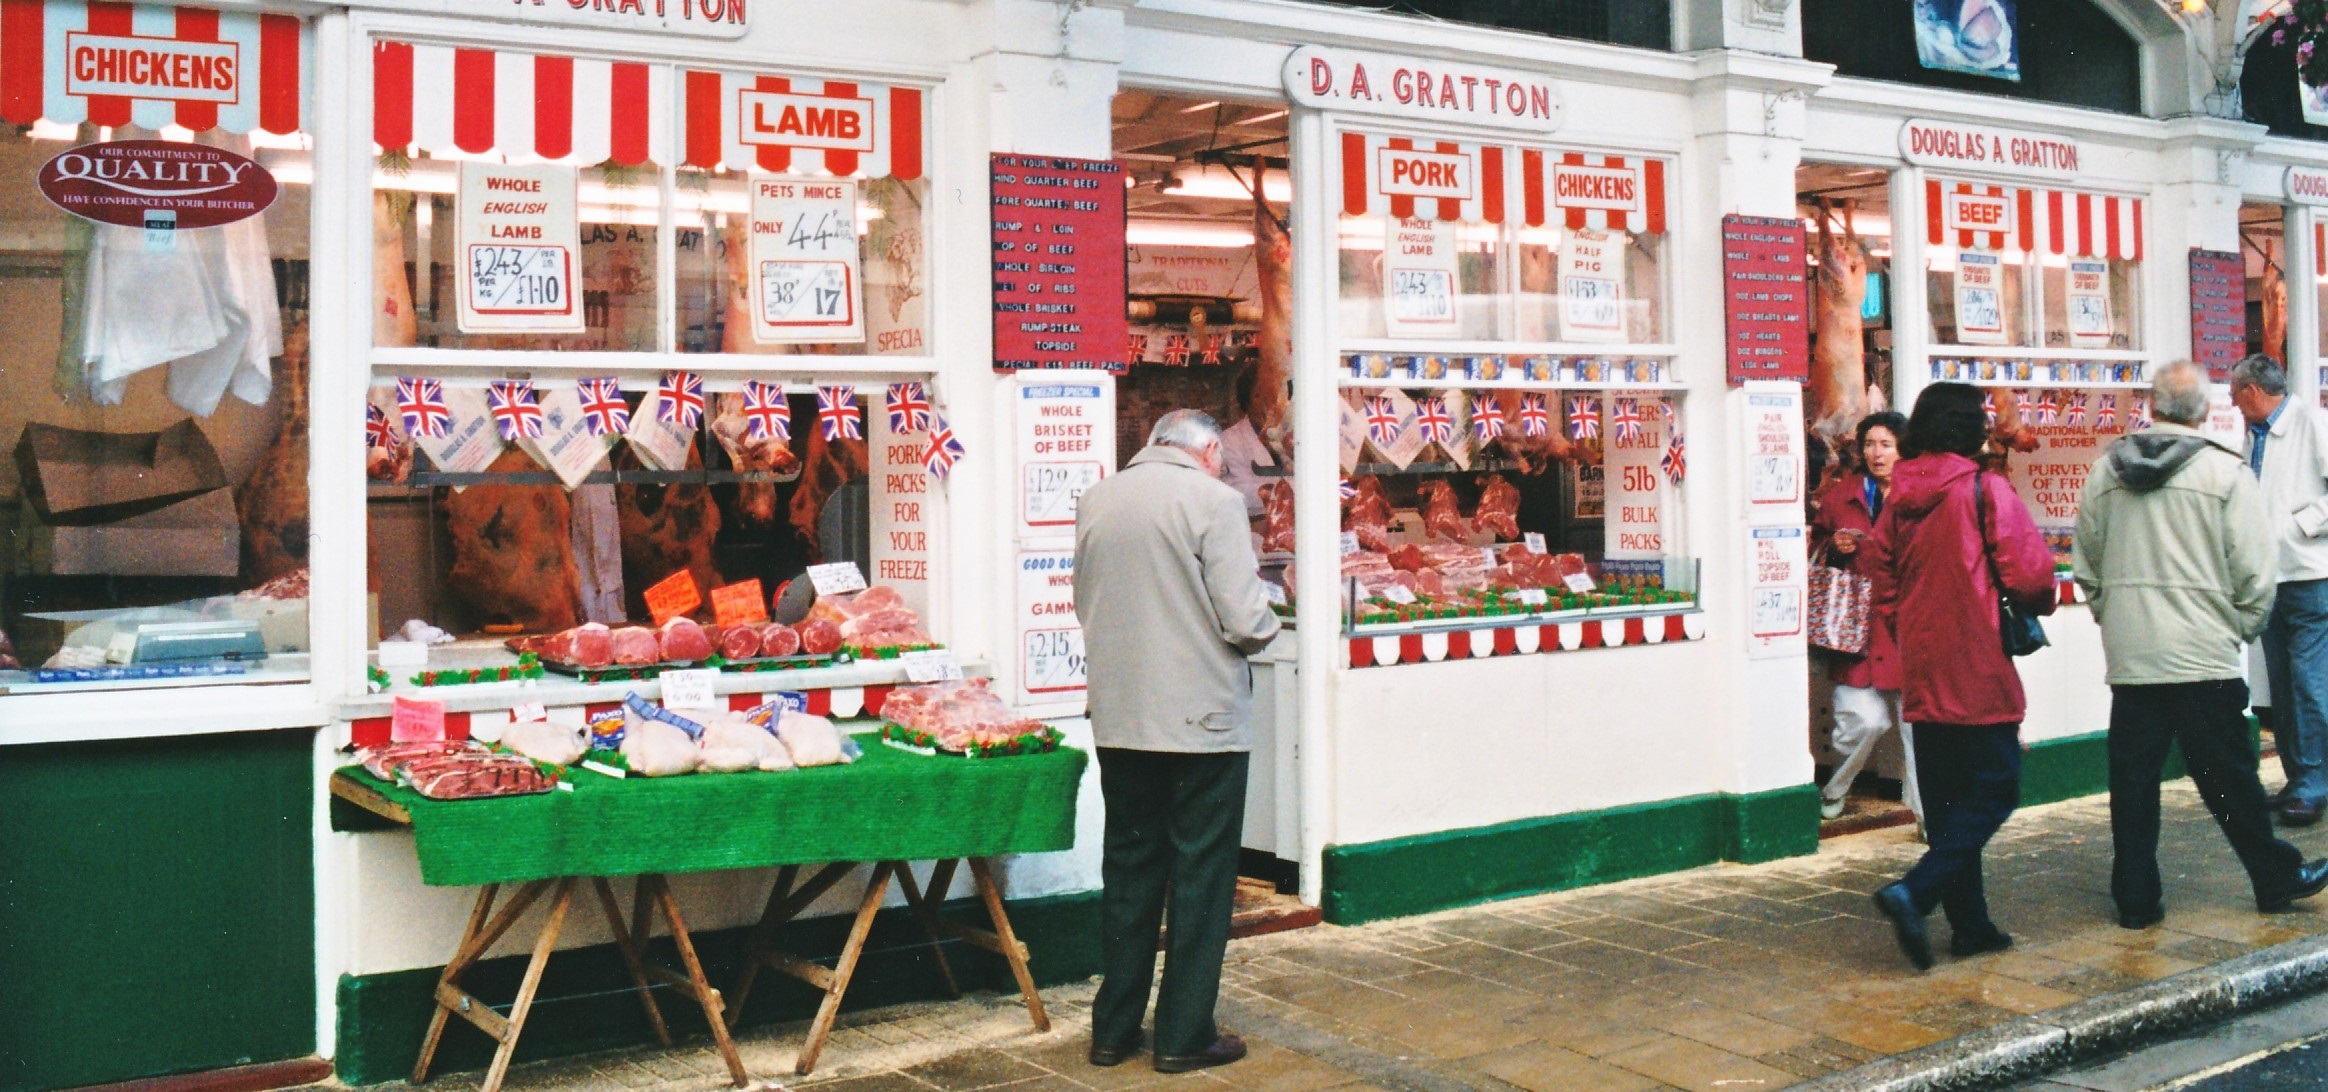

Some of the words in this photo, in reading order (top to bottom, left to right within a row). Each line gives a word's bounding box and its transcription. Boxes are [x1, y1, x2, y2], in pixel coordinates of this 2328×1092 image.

[75, 46, 233, 90] CHICKENS
[1311, 57, 1339, 96] D.
[1350, 63, 1382, 101] A.
[1393, 68, 1550, 119] GRATTON
[754, 102, 861, 139] LAMB
[100, 147, 123, 157] OUR
[127, 149, 201, 160] COMMITMENT
[207, 153, 220, 161] TO
[1911, 126, 1986, 161] DOUGLAS
[2011, 137, 2079, 172] GRATTON
[55, 153, 252, 184] QUALITY
[1393, 158, 1458, 188] PORK
[487, 177, 541, 192] WHOLE
[1024, 176, 1069, 186] QUARTER
[1073, 180, 1099, 189] BEEF
[1558, 173, 1634, 202] CHICKENS
[761, 184, 794, 198] PETS
[804, 186, 842, 199] MINCE
[64, 194, 89, 204] HAVE
[94, 196, 160, 206] CONFIDENCE
[163, 198, 174, 207] IN
[176, 199, 204, 208] YOUR
[208, 200, 255, 210] BUTCHER
[484, 202, 548, 214] ENGLISH
[1074, 201, 1099, 210] BEEF
[1959, 201, 2003, 225] BEEF
[492, 225, 542, 239] LAMB
[754, 221, 783, 234] ONLY
[995, 222, 1022, 232] RUMP
[1053, 225, 1074, 234] LOIN
[1001, 242, 1015, 251] OP
[1025, 243, 1038, 252] OF
[1049, 245, 1074, 254] BEEF
[1403, 245, 1433, 255] LAMB
[1575, 260, 1601, 272] PIG
[1028, 283, 1041, 292] OF
[1054, 284, 1075, 294] RIBS
[1035, 303, 1075, 313] BRISKET
[1021, 322, 1048, 332] RUMP
[1050, 323, 1081, 333] STEAK
[1036, 341, 1077, 350] TOPSIDE
[1041, 405, 1082, 416] WHOLE
[1035, 425, 1092, 436] BRISKET
[1035, 442, 1053, 453] OF
[1058, 440, 1092, 452] BEEF
[2050, 437, 2096, 448] BUTCHER
[888, 445, 923, 465] PORK
[886, 473, 926, 494] PACKS
[1623, 466, 1656, 492] 5lb
[2033, 478, 2053, 490] OF
[895, 502, 920, 522] FOR
[1623, 506, 1657, 523] BULK
[891, 531, 926, 551] YOUR
[1621, 533, 1661, 551] PACKS
[1023, 558, 1055, 570] GOOD
[592, 708, 623, 720] PAXO
